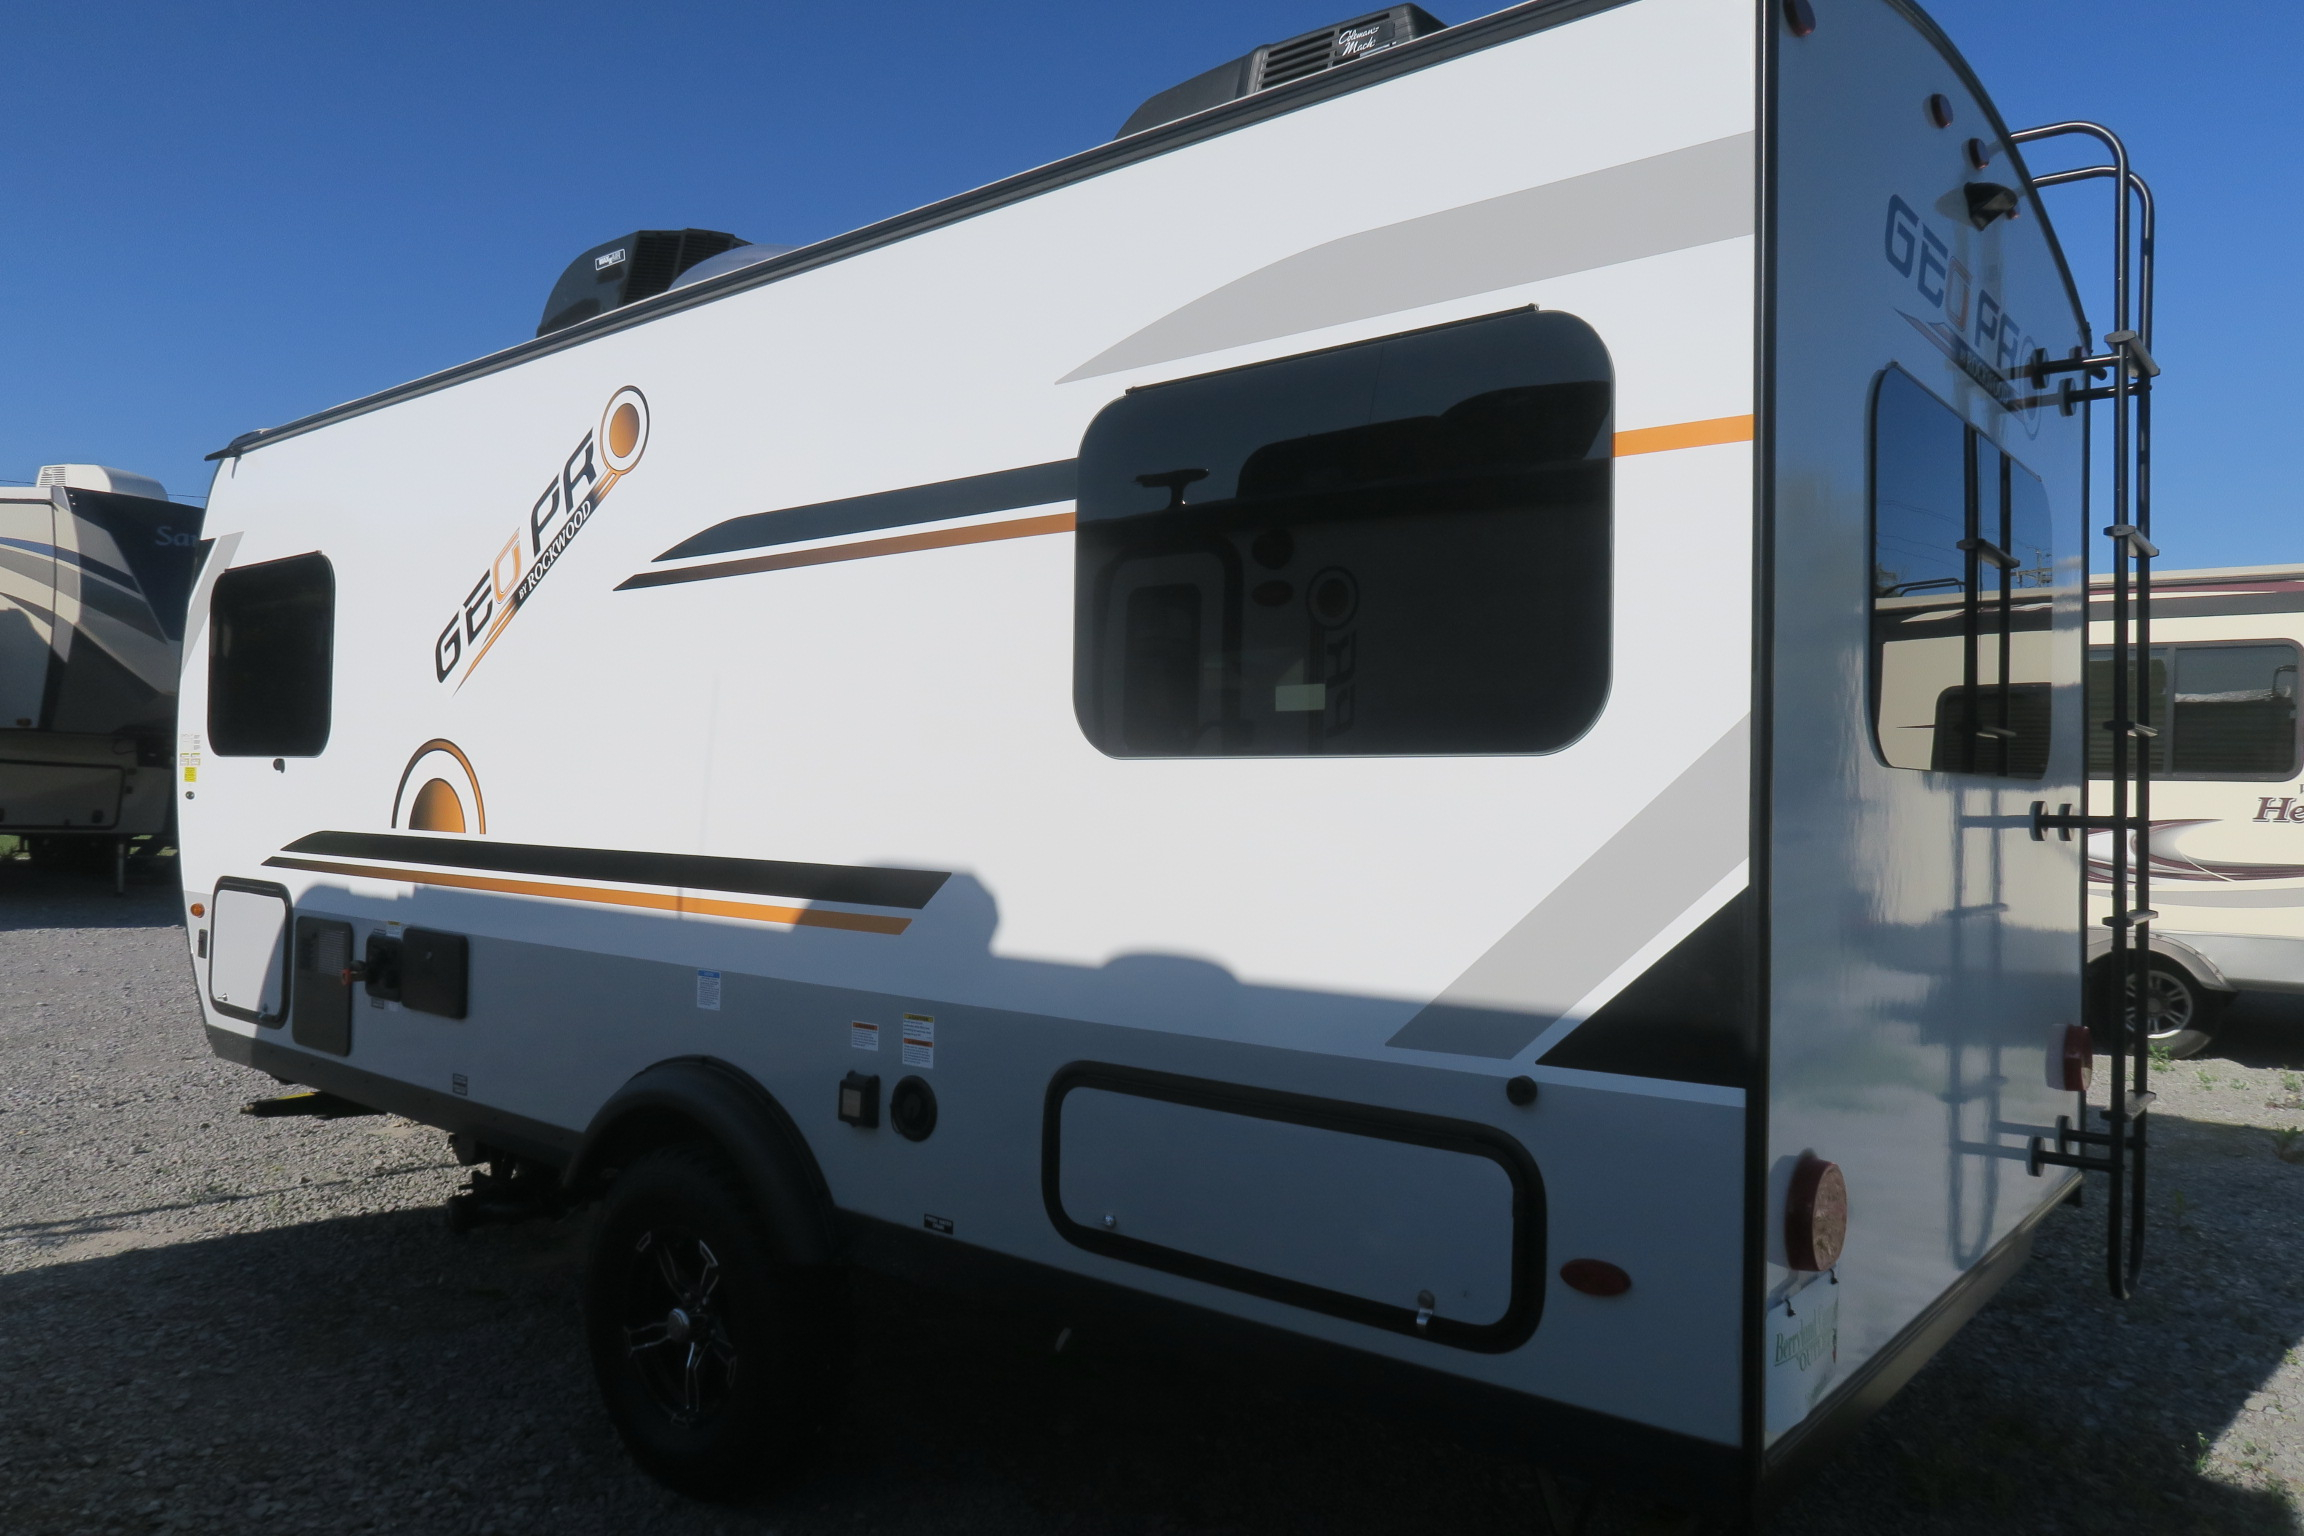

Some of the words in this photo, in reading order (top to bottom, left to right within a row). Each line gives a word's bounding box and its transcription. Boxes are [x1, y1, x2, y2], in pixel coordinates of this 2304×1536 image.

[435, 525, 521, 684] GEO
[518, 582, 528, 600] BY
[526, 500, 592, 593] ROCKWOOD
